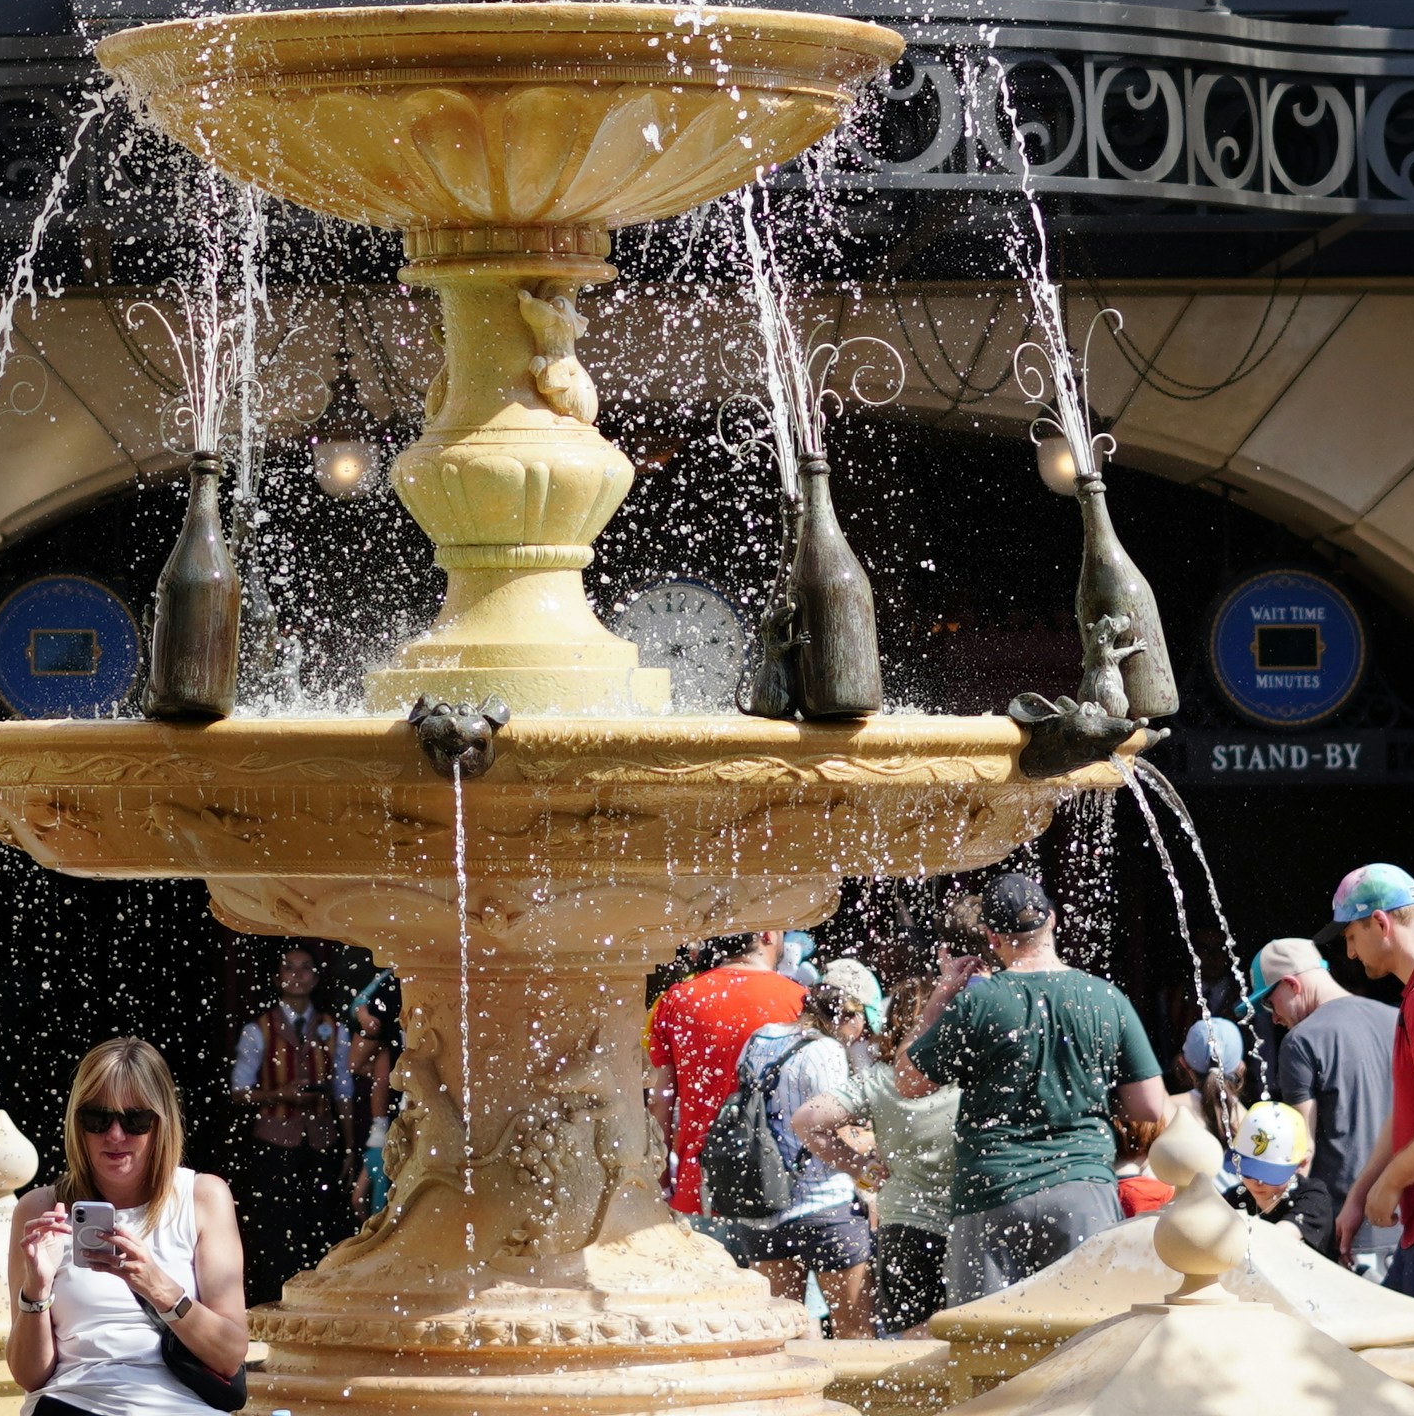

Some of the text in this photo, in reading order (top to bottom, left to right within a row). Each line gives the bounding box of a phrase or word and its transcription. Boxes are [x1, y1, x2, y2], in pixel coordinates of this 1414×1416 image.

[1250, 606, 1326, 620] WAIT TIME
[1255, 674, 1321, 689] MINUTES
[1211, 742, 1362, 772] STAND-BY
